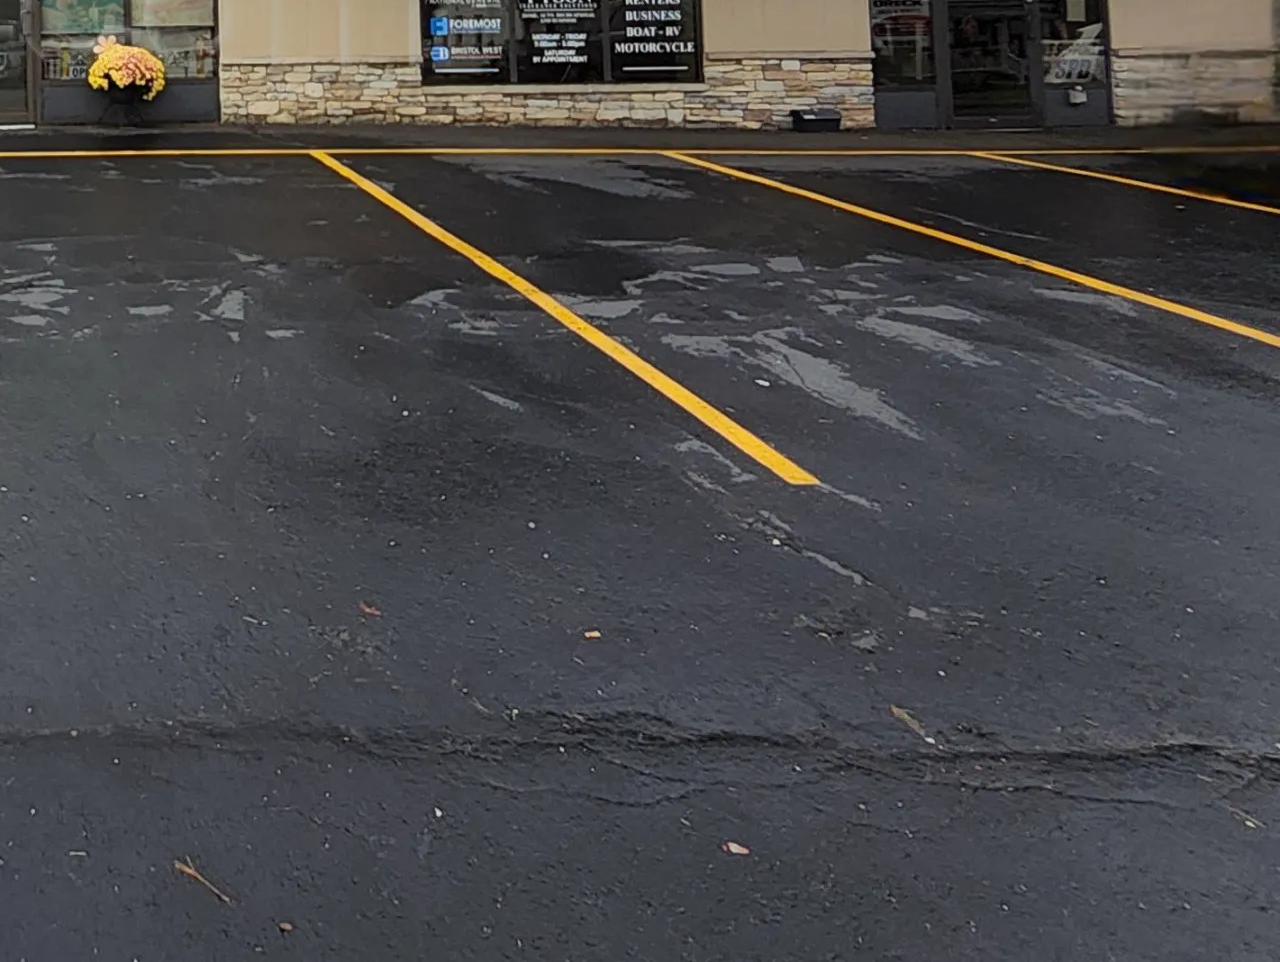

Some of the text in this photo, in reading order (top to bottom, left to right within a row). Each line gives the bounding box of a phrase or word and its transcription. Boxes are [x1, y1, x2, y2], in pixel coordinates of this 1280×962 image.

[625, 10, 682, 21] BUSINESS
[450, 18, 501, 30] FOREMOST
[626, 26, 657, 37] BOAT
[665, 26, 682, 37] RV
[614, 42, 695, 53] MOTORCYCLE
